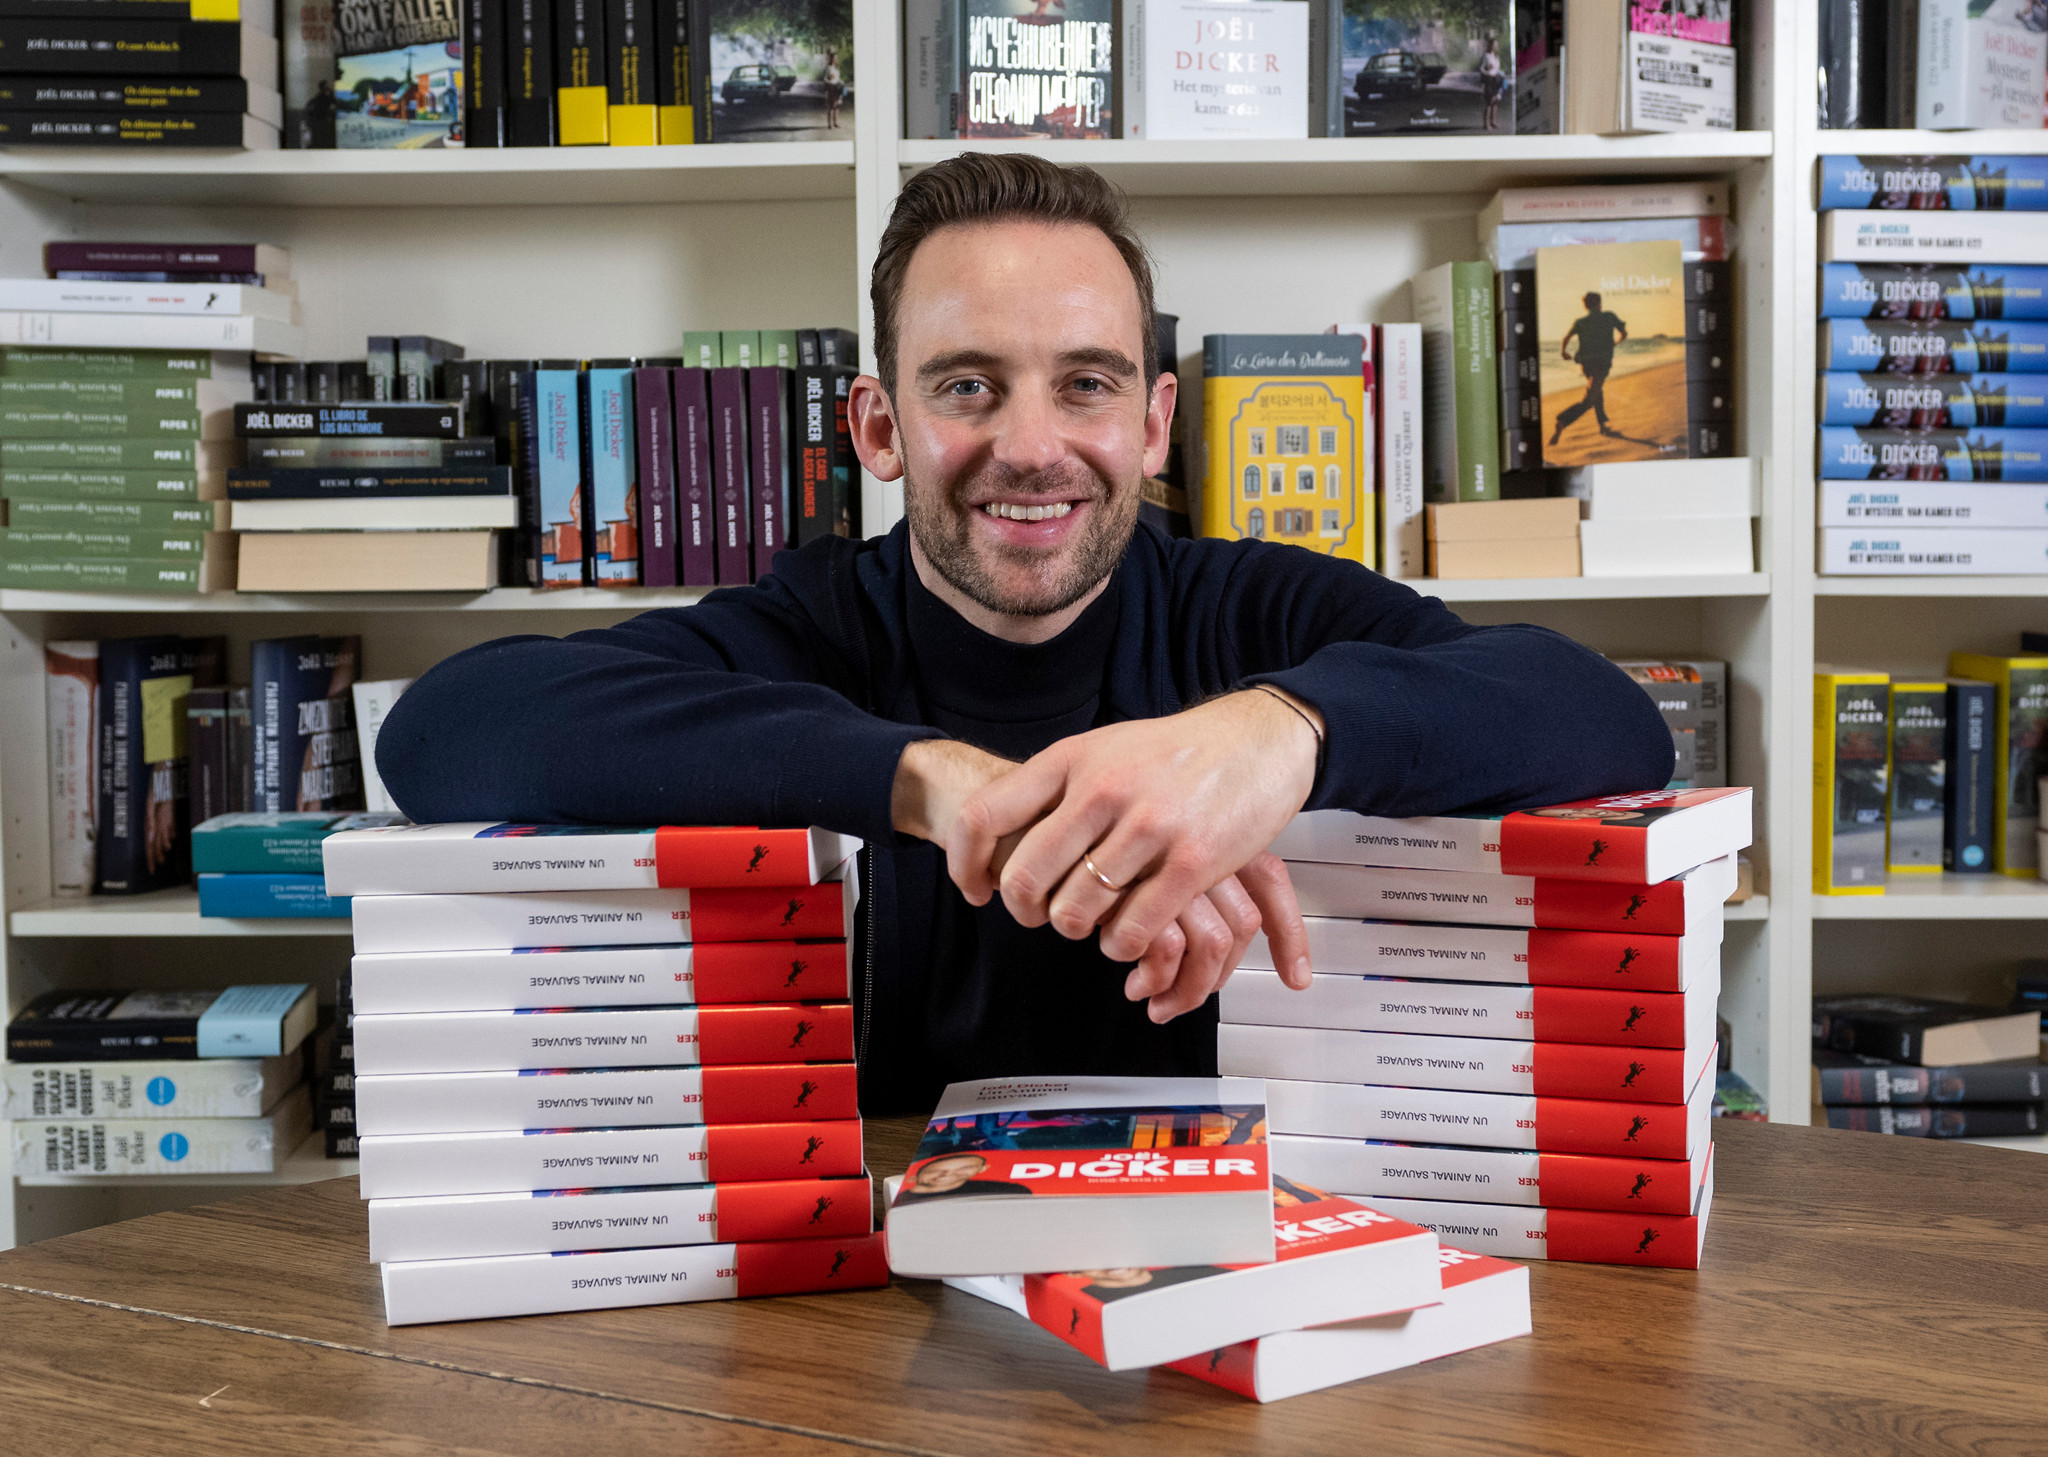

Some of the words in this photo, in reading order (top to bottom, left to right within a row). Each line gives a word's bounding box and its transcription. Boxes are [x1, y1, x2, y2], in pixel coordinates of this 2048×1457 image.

[1176, 50, 1280, 73] DICKER
[970, 71, 1040, 125] СТЕФАНИ
[1883, 171, 1941, 192] DICKER
[1883, 281, 1940, 301] DICKER
[1890, 336, 1946, 356] DICKER
[168, 360, 196, 369] PIPER
[156, 389, 184, 398] PIPER
[807, 376, 824, 401] JOËL
[1885, 388, 1943, 408] DICKER
[160, 420, 188, 430] PIPER
[246, 411, 272, 429] JOËL
[273, 413, 313, 429] DICKER
[807, 403, 823, 441] DICKER
[610, 419, 623, 459] Dicker
[154, 450, 182, 460] PIPER
[1881, 444, 1938, 464] DICKER
[157, 482, 185, 490] PIPER
[173, 512, 200, 520] PIPER
[164, 541, 191, 550] PIPER
[160, 572, 187, 580] PIPER
[1659, 701, 1688, 711] PIPER
[1838, 712, 1884, 724] DICKER
[1356, 834, 1398, 846] SAUVAGE
[1400, 838, 1440, 848] ANIMAL
[1442, 840, 1456, 850] UN
[492, 860, 542, 870] SAUVAGE
[544, 860, 586, 868] ANIMAL
[590, 858, 604, 868] UN
[1382, 890, 1428, 902] SAUVAGE
[1430, 892, 1470, 902] ANIMAL
[1472, 894, 1488, 904] UN
[528, 914, 578, 924] SAUVAGE
[582, 913, 624, 924] ANIMAL
[628, 912, 642, 922] UN
[1378, 946, 1426, 958] SAUVAGE
[1427, 950, 1468, 960] ANIMAL
[1470, 952, 1486, 960] UN
[530, 976, 580, 986] SAUVAGE
[582, 974, 626, 984] ANIMAL
[628, 974, 644, 982] UN
[1380, 1004, 1426, 1014] SAUVAGE
[1428, 1006, 1468, 1016] ANIMAL
[1472, 1008, 1488, 1018] UN
[532, 1036, 582, 1048] SAUVAGE
[584, 1036, 628, 1046] ANIMAL
[632, 1036, 646, 1044] UN
[1376, 1056, 1422, 1066] SAUVAGE
[1424, 1058, 1466, 1070] ANIMAL
[1468, 1062, 1484, 1070] UN
[538, 1098, 588, 1108] SAUVAGE
[590, 1096, 634, 1106] ANIMAL
[638, 1096, 654, 1104] UN
[1380, 1110, 1426, 1122] SAUVAGE
[1428, 1114, 1470, 1124] ANIMAL
[1474, 1116, 1488, 1126] UN
[542, 1156, 594, 1168] SAUVAGE
[596, 1156, 638, 1166] ANIMAL
[642, 1154, 658, 1162] UN
[1100, 1152, 1168, 1162] JOËL
[1010, 1158, 1257, 1179] DICKER
[1382, 1168, 1428, 1180] SAUVAGE
[1430, 1172, 1472, 1182] ANIMAL
[1474, 1174, 1490, 1184] UN
[552, 1218, 602, 1230] SAUVAGE
[606, 1216, 648, 1228] ANIMAL
[652, 1216, 668, 1224] UN
[1438, 1224, 1480, 1236] ANIMAL
[1482, 1228, 1498, 1236] UN
[572, 1276, 622, 1288] SAUVAGE
[624, 1274, 668, 1284] ANIMAL
[672, 1272, 686, 1282] UN
